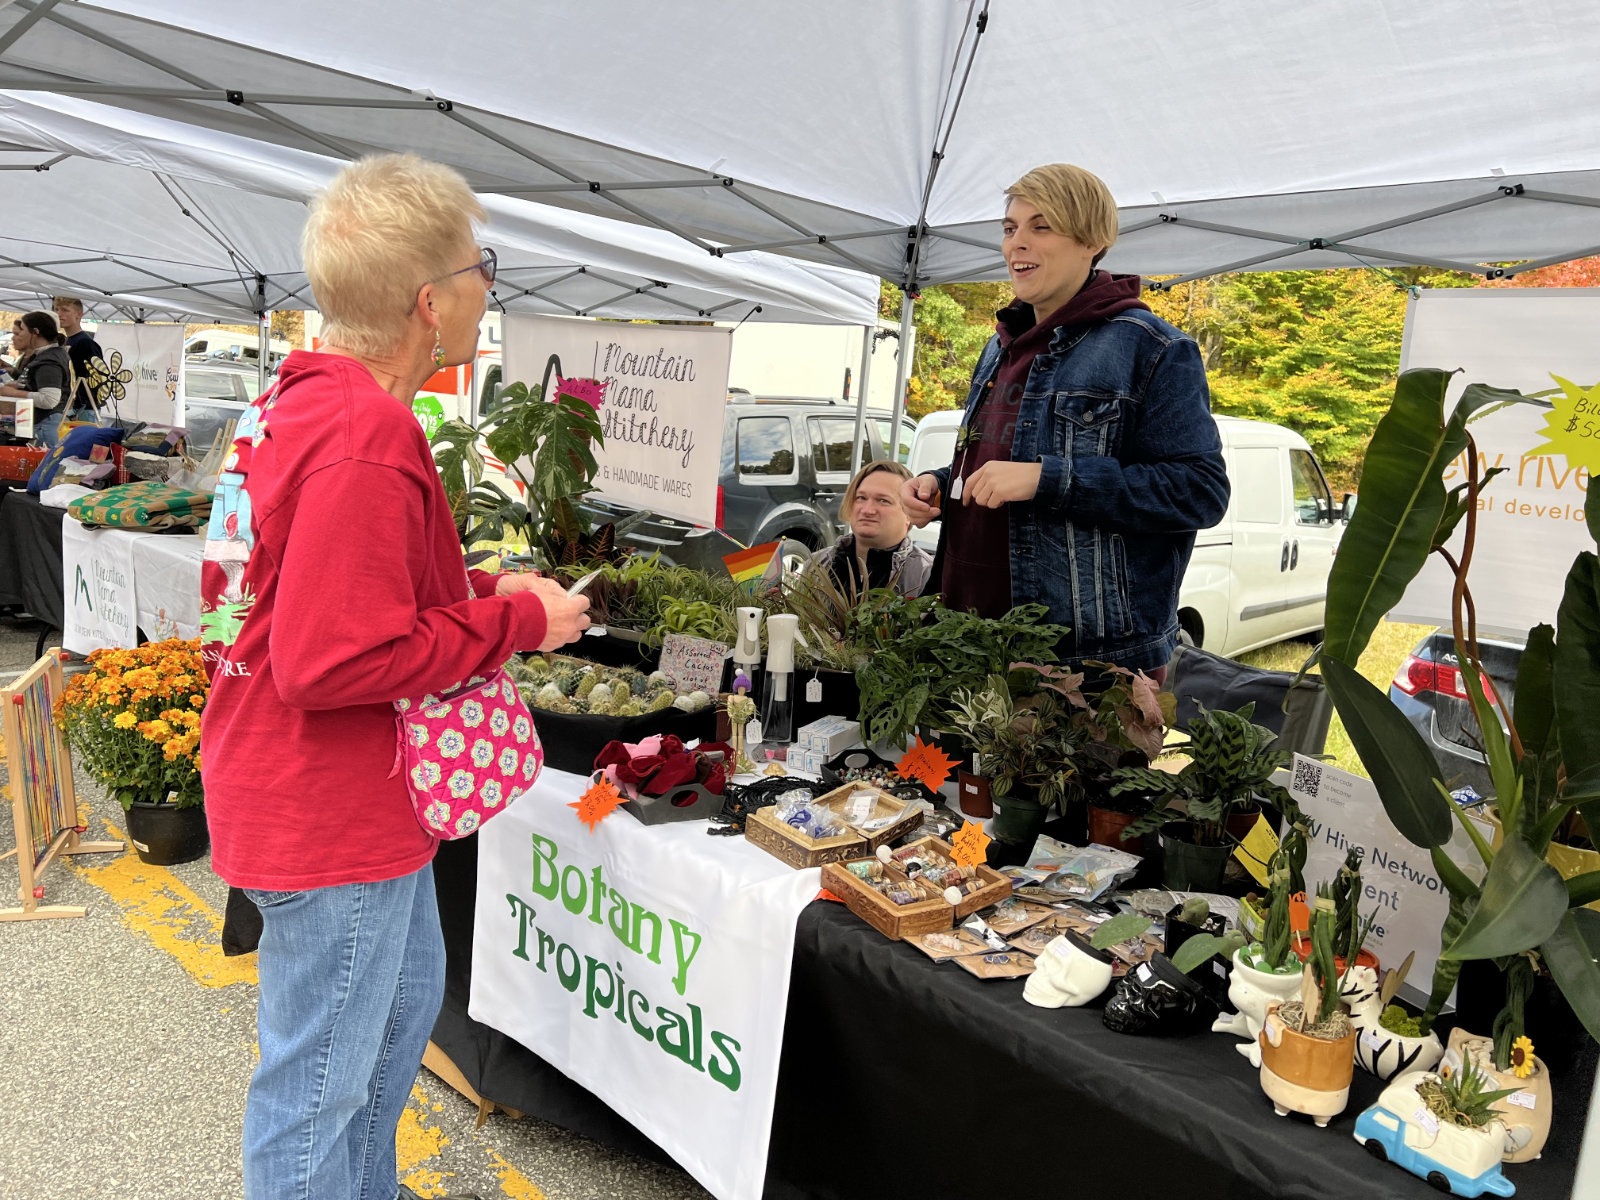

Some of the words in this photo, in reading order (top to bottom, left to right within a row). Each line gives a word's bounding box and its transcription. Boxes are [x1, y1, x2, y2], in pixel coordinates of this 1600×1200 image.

[142, 362, 158, 381] hive
[603, 343, 696, 382] Mountain
[601, 376, 657, 412] Mama
[602, 409, 695, 468] Stitchery
[604, 466, 610, 479] &
[613, 467, 660, 491] HANDMADE
[663, 478, 692, 498] WARES
[1504, 498, 1586, 522] develo
[677, 645, 711, 658] Assorted
[685, 659, 714, 671] Cactus
[1326, 827, 1366, 859] Hive
[1371, 847, 1448, 896] Networ
[532, 832, 702, 995] Botany
[506, 893, 742, 1092] Tropicals
